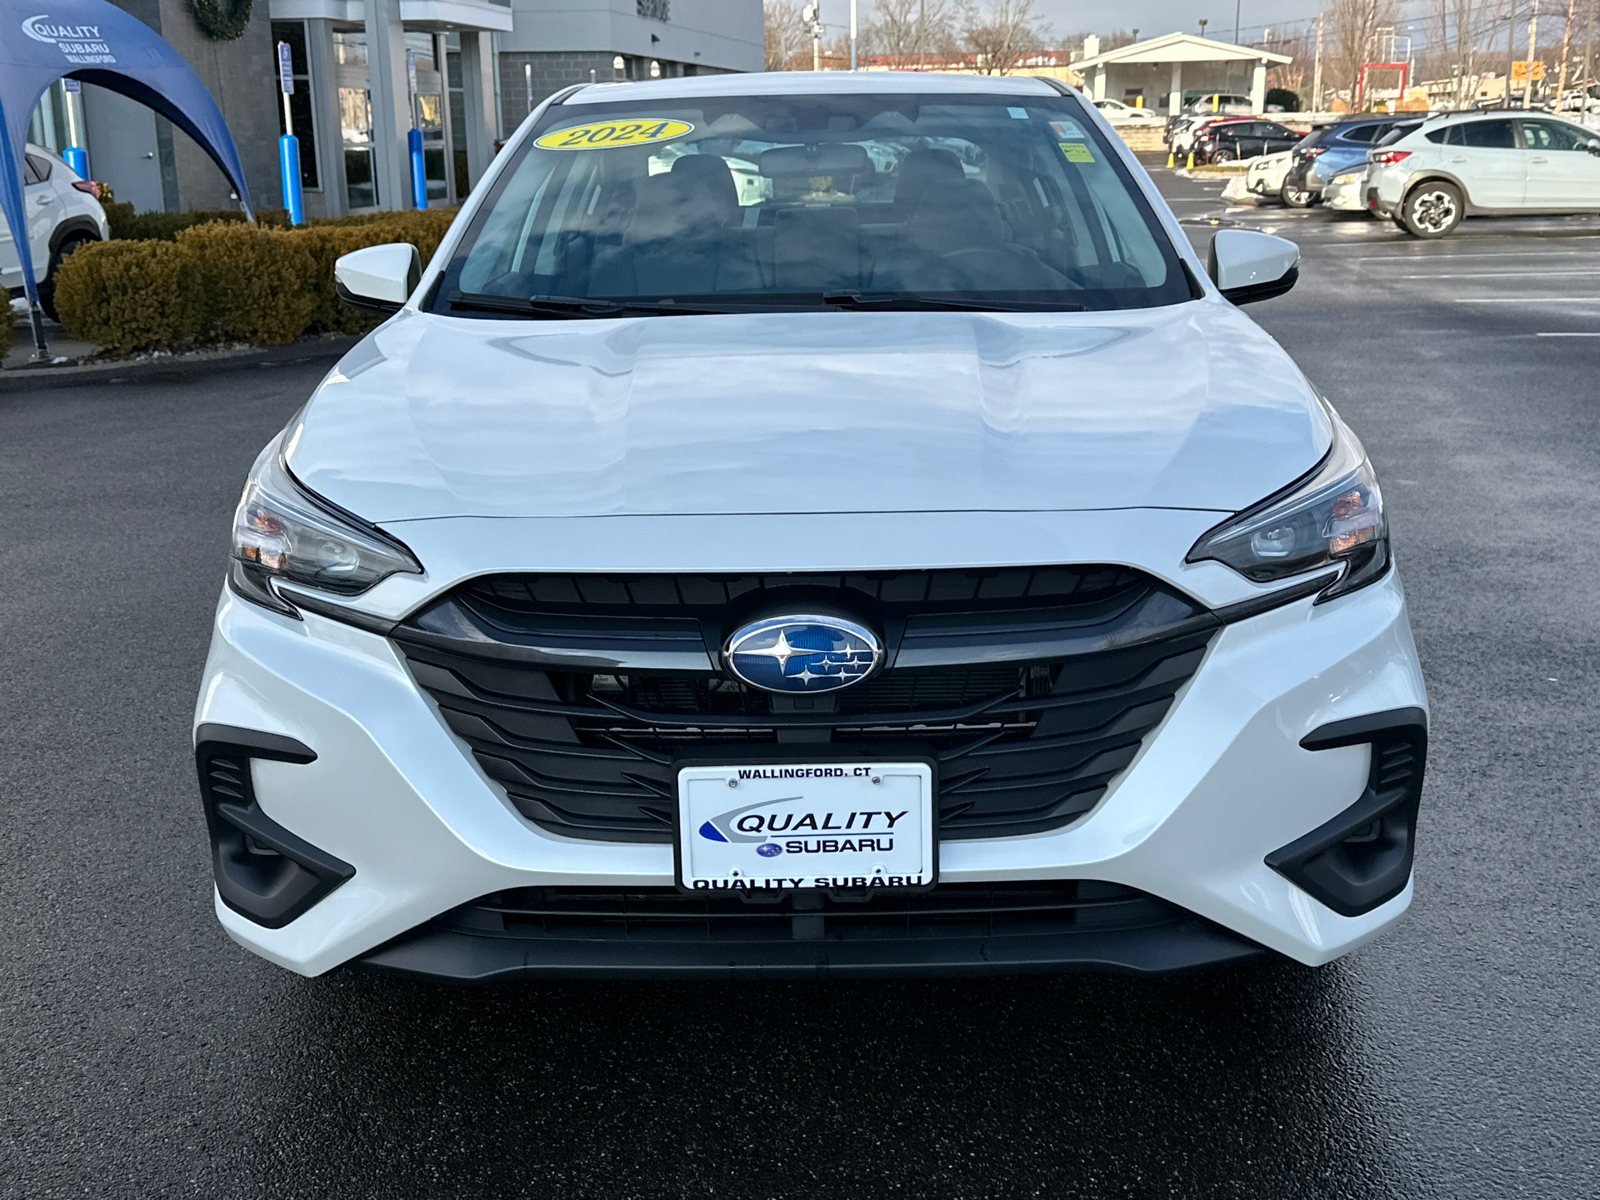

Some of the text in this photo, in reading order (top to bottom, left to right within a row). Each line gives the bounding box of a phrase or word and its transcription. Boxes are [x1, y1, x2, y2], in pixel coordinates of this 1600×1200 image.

[34, 23, 100, 38] QUALITY
[58, 42, 110, 54] SUBARU
[558, 122, 669, 147] 2024
[853, 767, 871, 777] CT
[736, 811, 909, 833] QUALITY
[785, 838, 894, 854] SUBARU
[692, 876, 922, 890] QUALITY SUBARU
